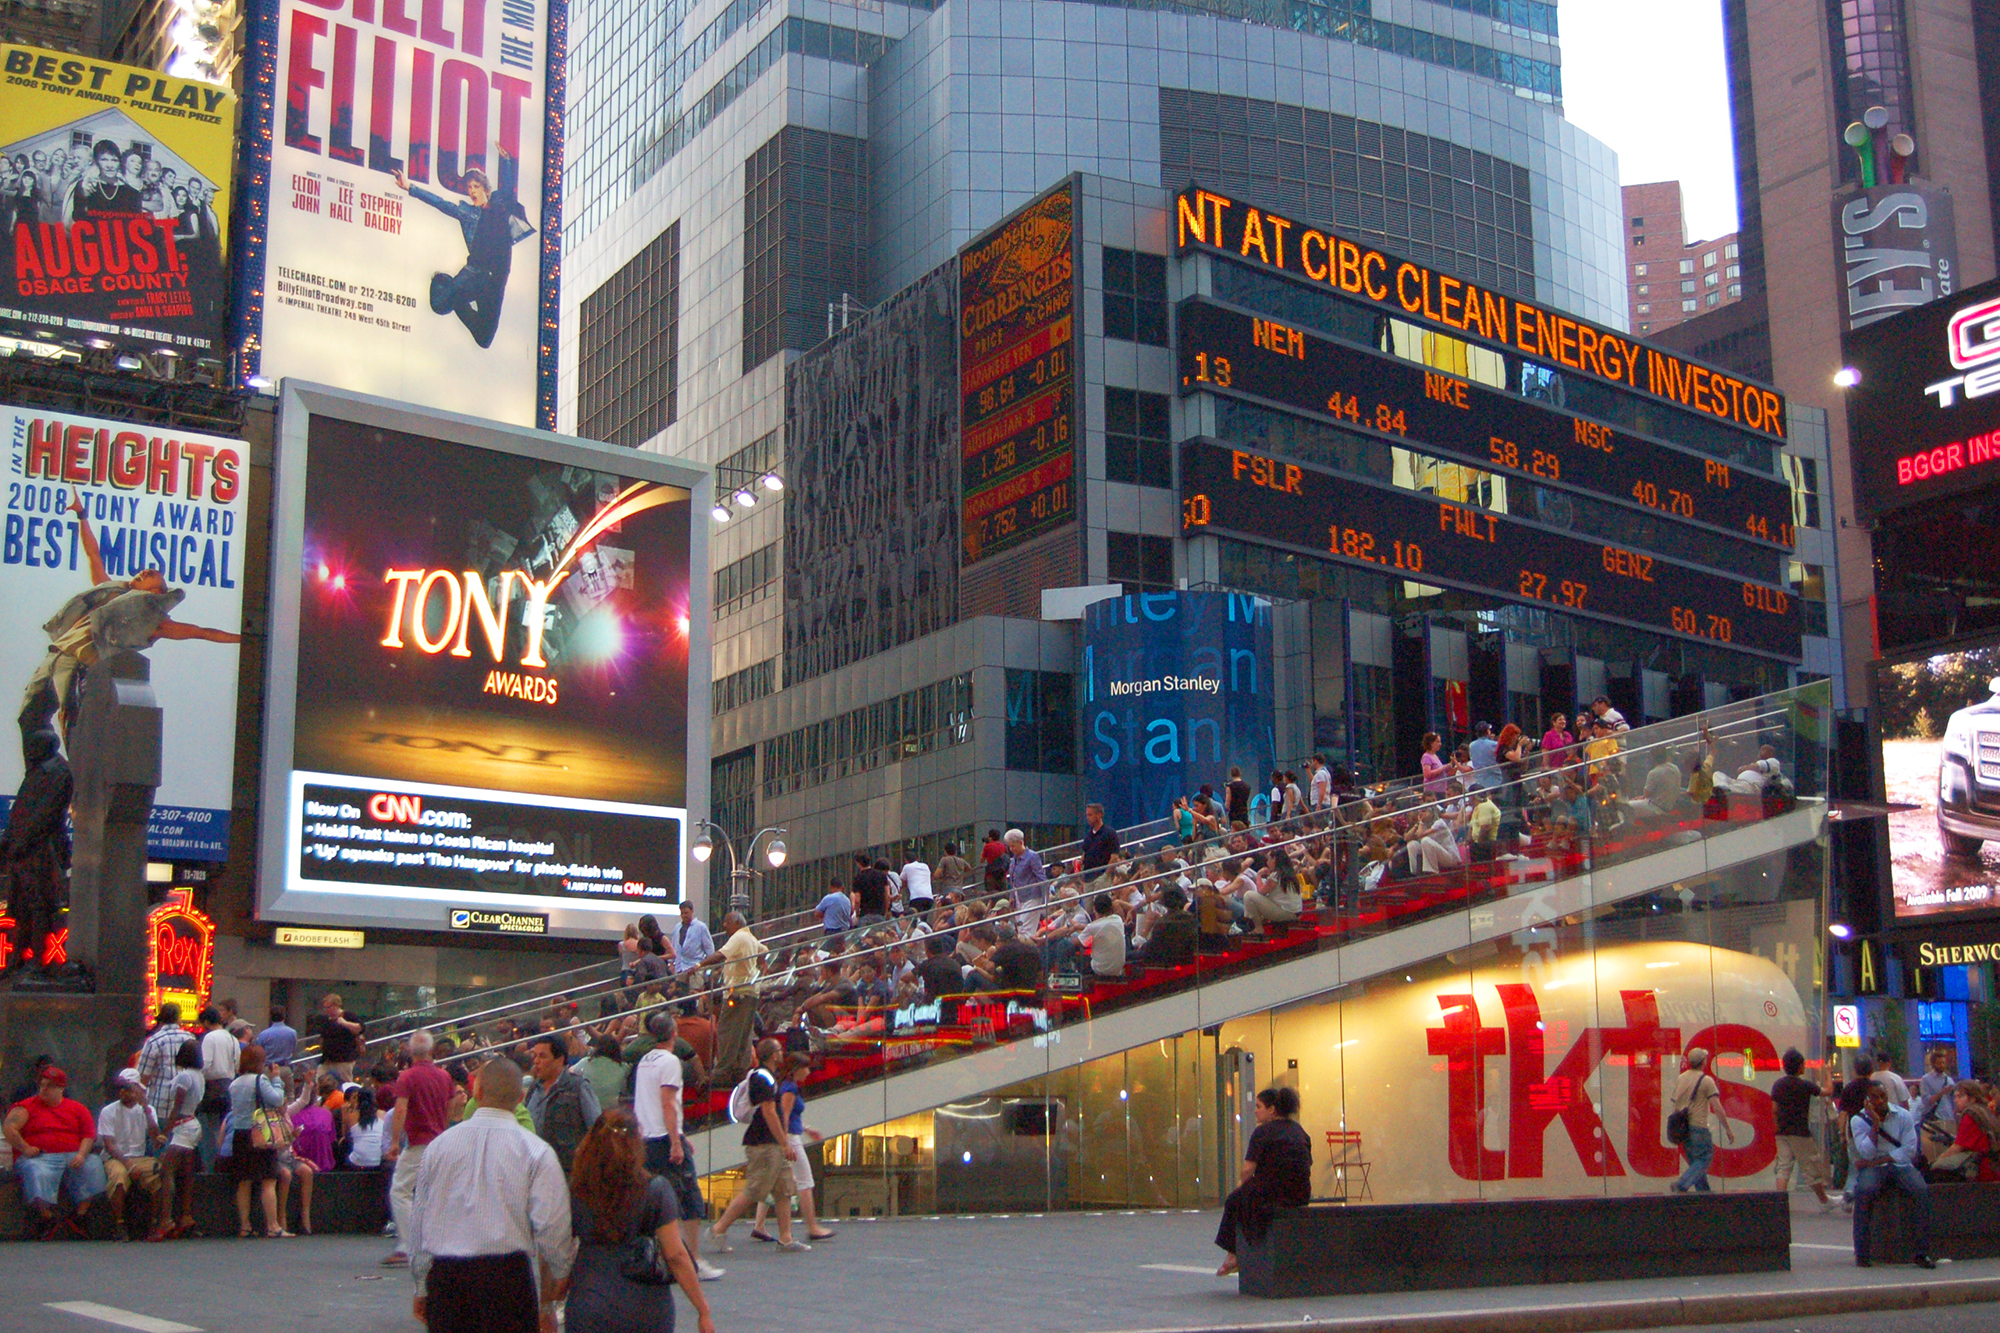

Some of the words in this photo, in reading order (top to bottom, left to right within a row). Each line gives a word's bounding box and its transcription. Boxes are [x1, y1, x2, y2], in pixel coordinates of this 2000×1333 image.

[502, 0, 535, 32] MU
[500, 32, 533, 71] THE
[4, 50, 112, 91] BEST
[124, 73, 226, 113] PLAY
[6, 76, 38, 88] 2008
[41, 82, 74, 95] TONY
[76, 89, 120, 105] AWARD
[130, 101, 186, 118] PULITZER
[188, 112, 222, 125] PRIZE
[284, 8, 532, 205] ELLIOT
[292, 174, 321, 197] ELTON
[292, 193, 320, 214] JOHN
[339, 187, 353, 205] LEE
[330, 202, 353, 223] HALL
[360, 192, 403, 218] STEPHEN
[16, 217, 188, 279] AUGUST:
[18, 277, 94, 296] OSAGE
[102, 272, 188, 291] COUNTY
[277, 280, 374, 312] BillyElliotBroadway.com
[278, 266, 346, 292] TELECHARGE.COM
[349, 285, 357, 294] or
[361, 286, 417, 308] 212-239-6200
[962, 250, 1072, 339] CURRENCIES
[285, 297, 314, 311] IMPERIAL
[317, 304, 342, 318] THEATRE
[358, 314, 374, 324] West
[376, 317, 390, 328] 45th
[392, 321, 411, 333] Street
[1178, 190, 1231, 249] NT
[1241, 208, 1291, 268] AT
[1301, 229, 1387, 301] CIBC
[1397, 263, 1507, 343] CLEAN
[1515, 302, 1639, 387] ENERGY
[1647, 349, 1783, 437] INVESTOR
[1253, 317, 1304, 360] NEM
[1029, 349, 1065, 385] -0.01
[1425, 370, 1470, 410] NKE
[1328, 391, 1407, 437] 44.84
[12, 416, 25, 449] THE
[1030, 415, 1068, 451] -0.16
[1575, 417, 1614, 452] NSC
[10, 456, 22, 475] IN
[25, 418, 240, 505] HEIGHTS
[1232, 450, 1303, 496] FSLR
[1490, 437, 1560, 480] 58.29
[1705, 459, 1729, 489] PM
[1897, 441, 1965, 485] BGGR
[7, 482, 67, 515] 2008
[82, 491, 140, 524] TONY
[153, 501, 235, 536] AWARD
[1031, 483, 1068, 519] +0.01
[1632, 480, 1694, 518] 40.70
[1439, 504, 1498, 542] FWLT
[3, 514, 80, 571] BEST
[100, 525, 235, 589] MUSICAL
[1329, 525, 1422, 572] 182.10
[1602, 547, 1654, 583] GENZ
[1519, 569, 1588, 609] 27.97
[1743, 583, 1788, 615] GILD
[381, 568, 569, 668] TONY
[1672, 606, 1732, 642] 60.70
[484, 670, 558, 705] AWARDS
[1110, 679, 1161, 696] Morgan
[1163, 675, 1220, 694] Stanley
[307, 800, 338, 818] Now
[340, 804, 361, 819] On
[147, 825, 184, 836] AL.COM
[314, 823, 349, 838] Heidi
[351, 825, 382, 841] Pratt
[384, 829, 418, 844] taken
[420, 832, 433, 845] to
[435, 833, 471, 849] Costa
[473, 836, 507, 851] Rican
[508, 839, 555, 856] hospital
[341, 849, 395, 863] squeaks
[396, 853, 425, 866] past
[515, 860, 533, 873] for
[534, 862, 601, 879] photo-finish
[602, 867, 623, 880] win
[1907, 891, 1944, 907] Available
[1946, 888, 1962, 903] Fall
[1964, 885, 1987, 900] 2009
[293, 935, 322, 944] ADOBE
[324, 936, 350, 945] FLASH
[1840, 1036, 1854, 1044] NEW
[1426, 983, 1780, 1181] tkts
